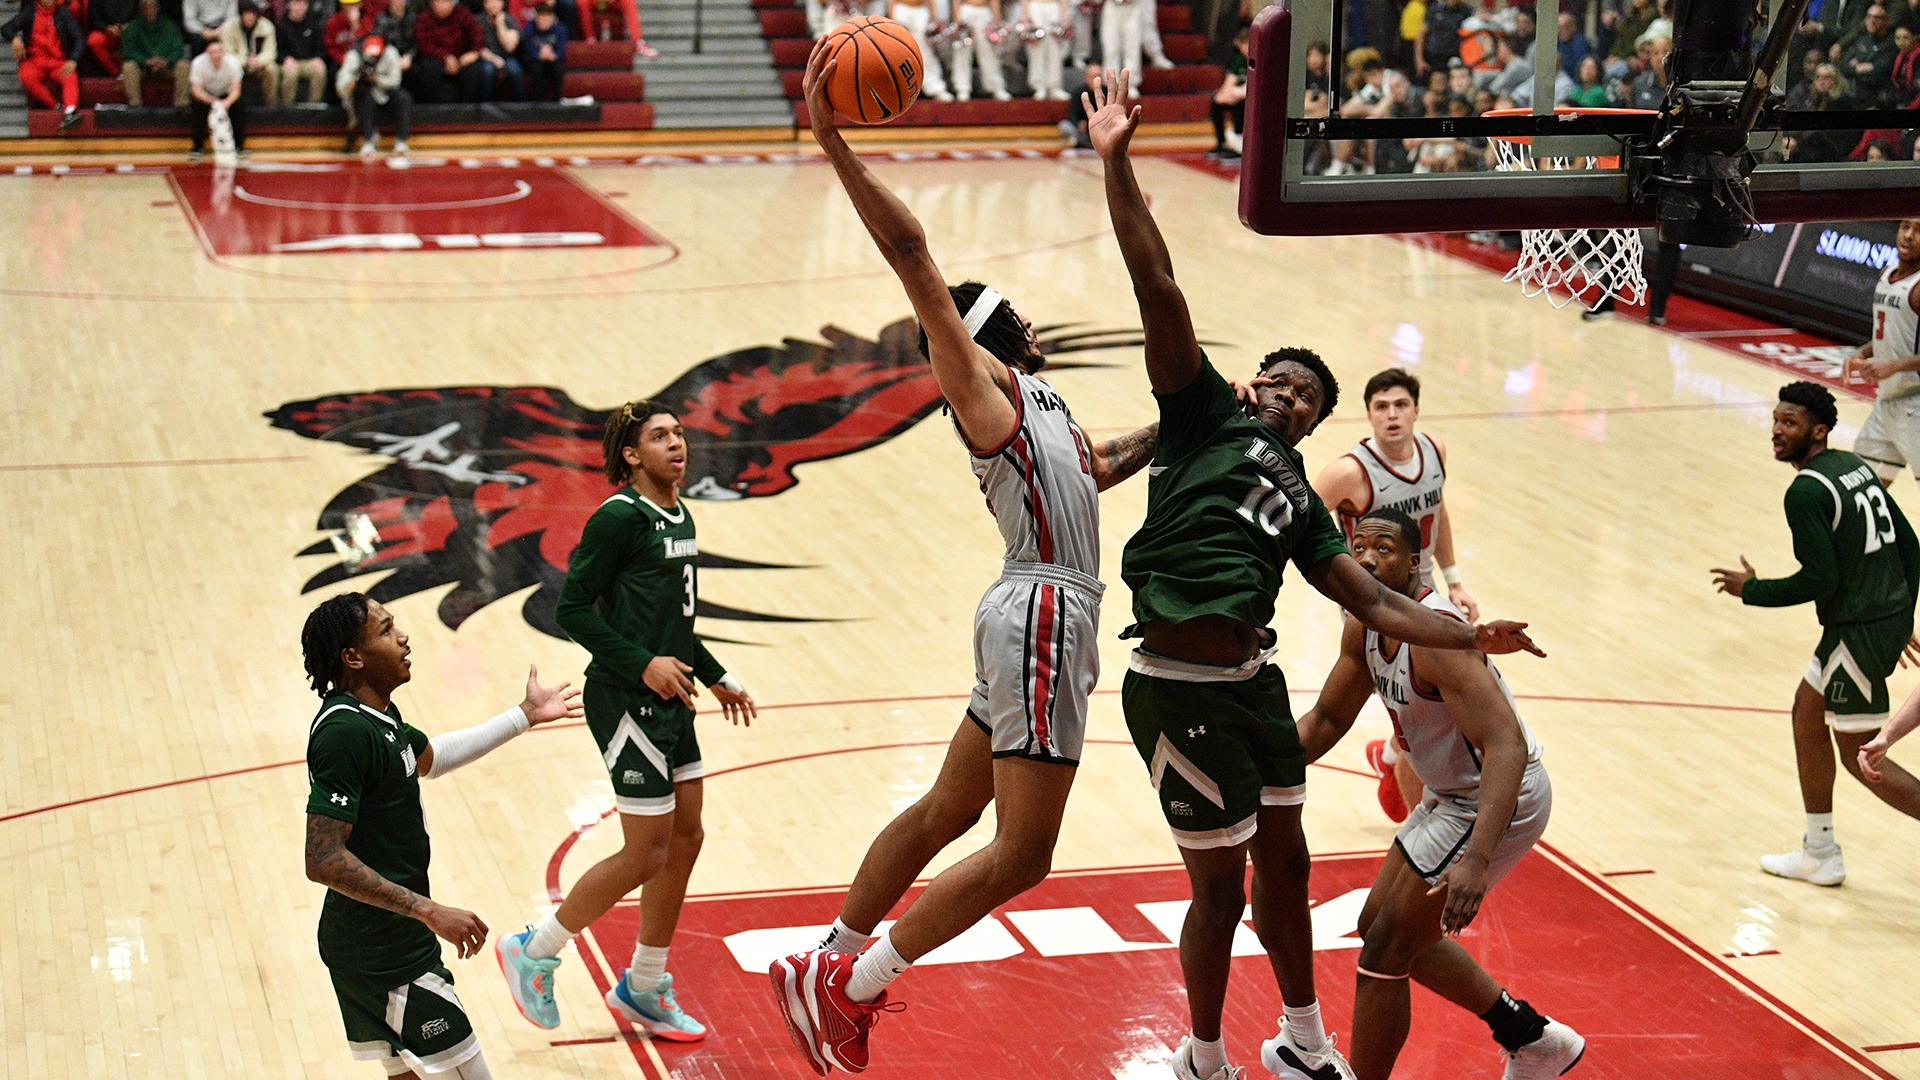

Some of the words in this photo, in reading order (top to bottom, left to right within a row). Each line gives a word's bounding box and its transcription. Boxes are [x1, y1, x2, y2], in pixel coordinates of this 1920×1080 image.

[1875, 310, 1886, 340] 3
[1235, 472, 1294, 537] 10
[1244, 437, 1309, 515] LOYOLA
[1854, 484, 1896, 555] 23
[682, 563, 695, 617] 3
[1831, 680, 1848, 703] L
